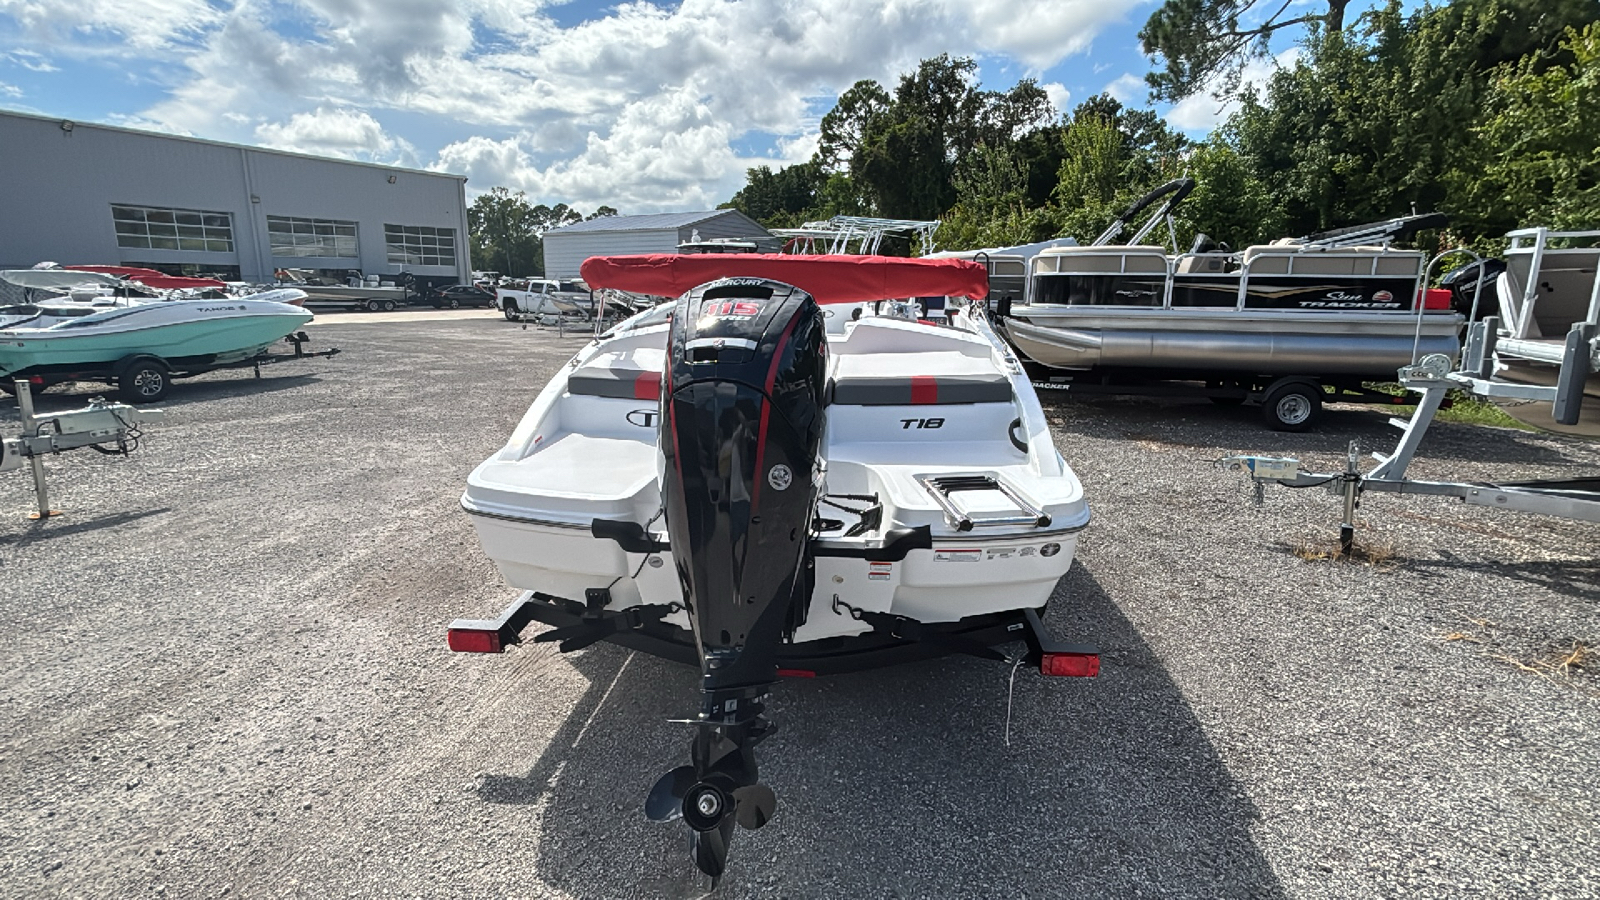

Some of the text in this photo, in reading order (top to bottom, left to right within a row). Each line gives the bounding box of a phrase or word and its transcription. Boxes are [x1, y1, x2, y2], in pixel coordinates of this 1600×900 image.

[710, 278, 765, 288] MERCURY
[1323, 291, 1362, 301] Sun
[707, 302, 759, 316] 115
[1031, 382, 1070, 390] RACKER
[900, 418, 945, 429] T18
